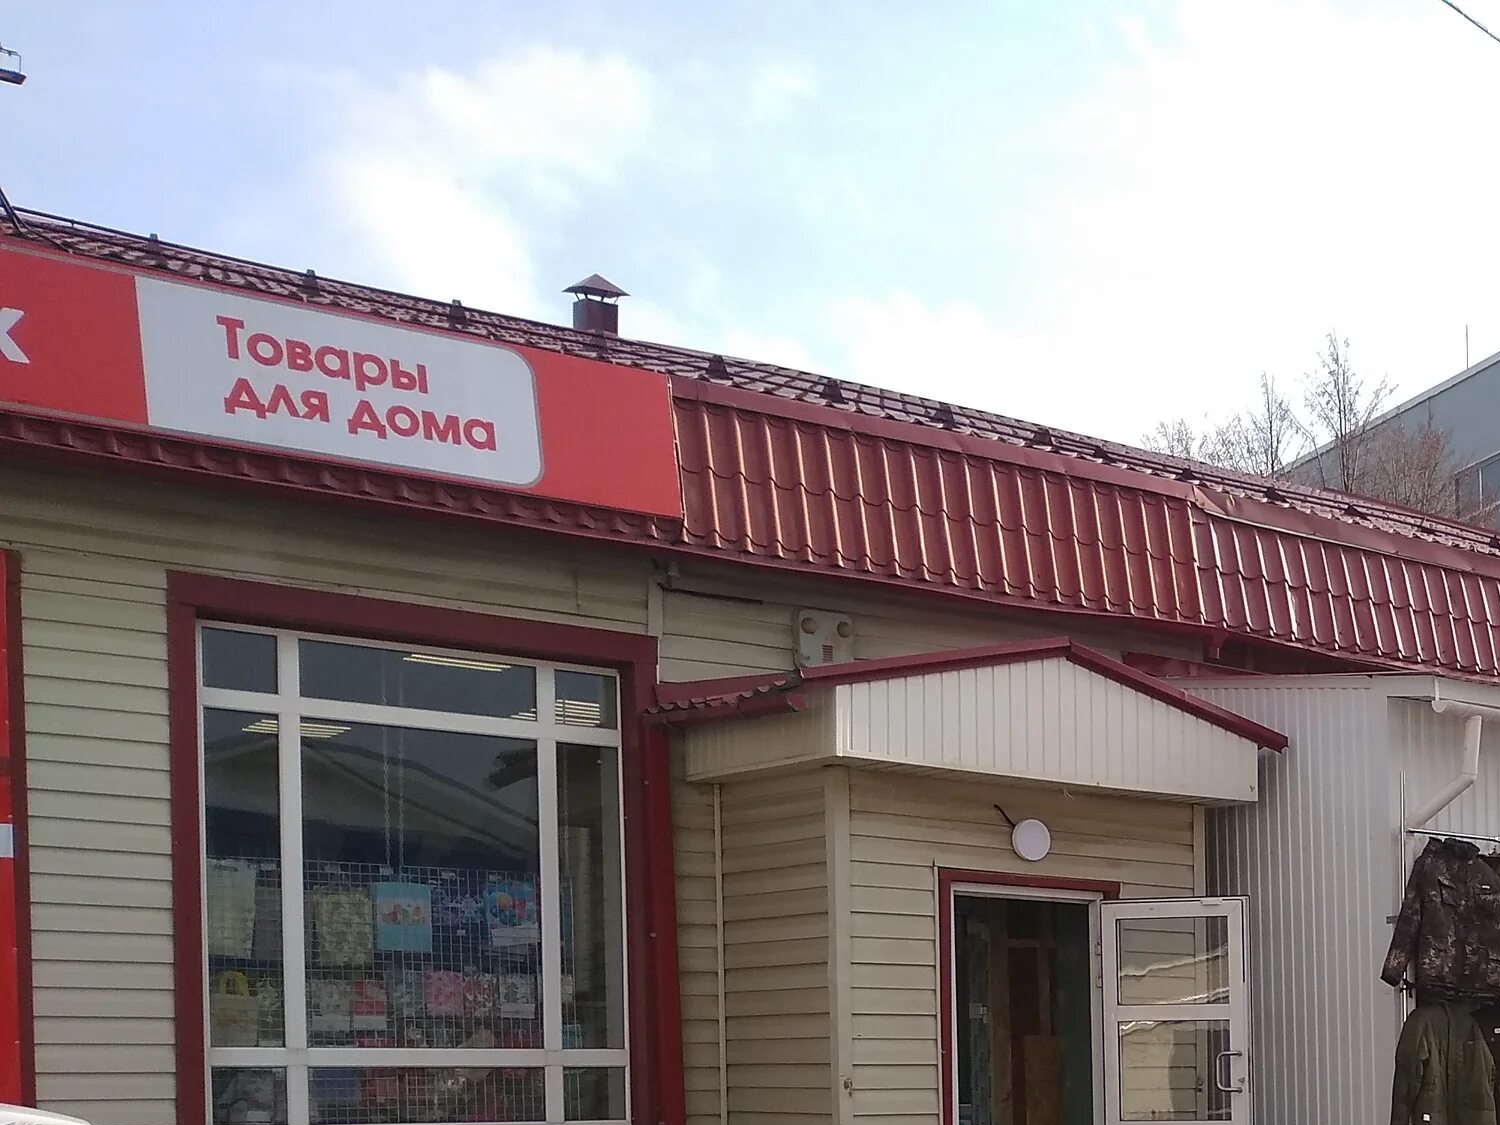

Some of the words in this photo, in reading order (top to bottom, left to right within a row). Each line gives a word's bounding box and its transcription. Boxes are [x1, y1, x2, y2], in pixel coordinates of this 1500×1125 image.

[216, 315, 429, 394] Товары
[224, 377, 330, 423] для
[348, 398, 497, 452] дома
